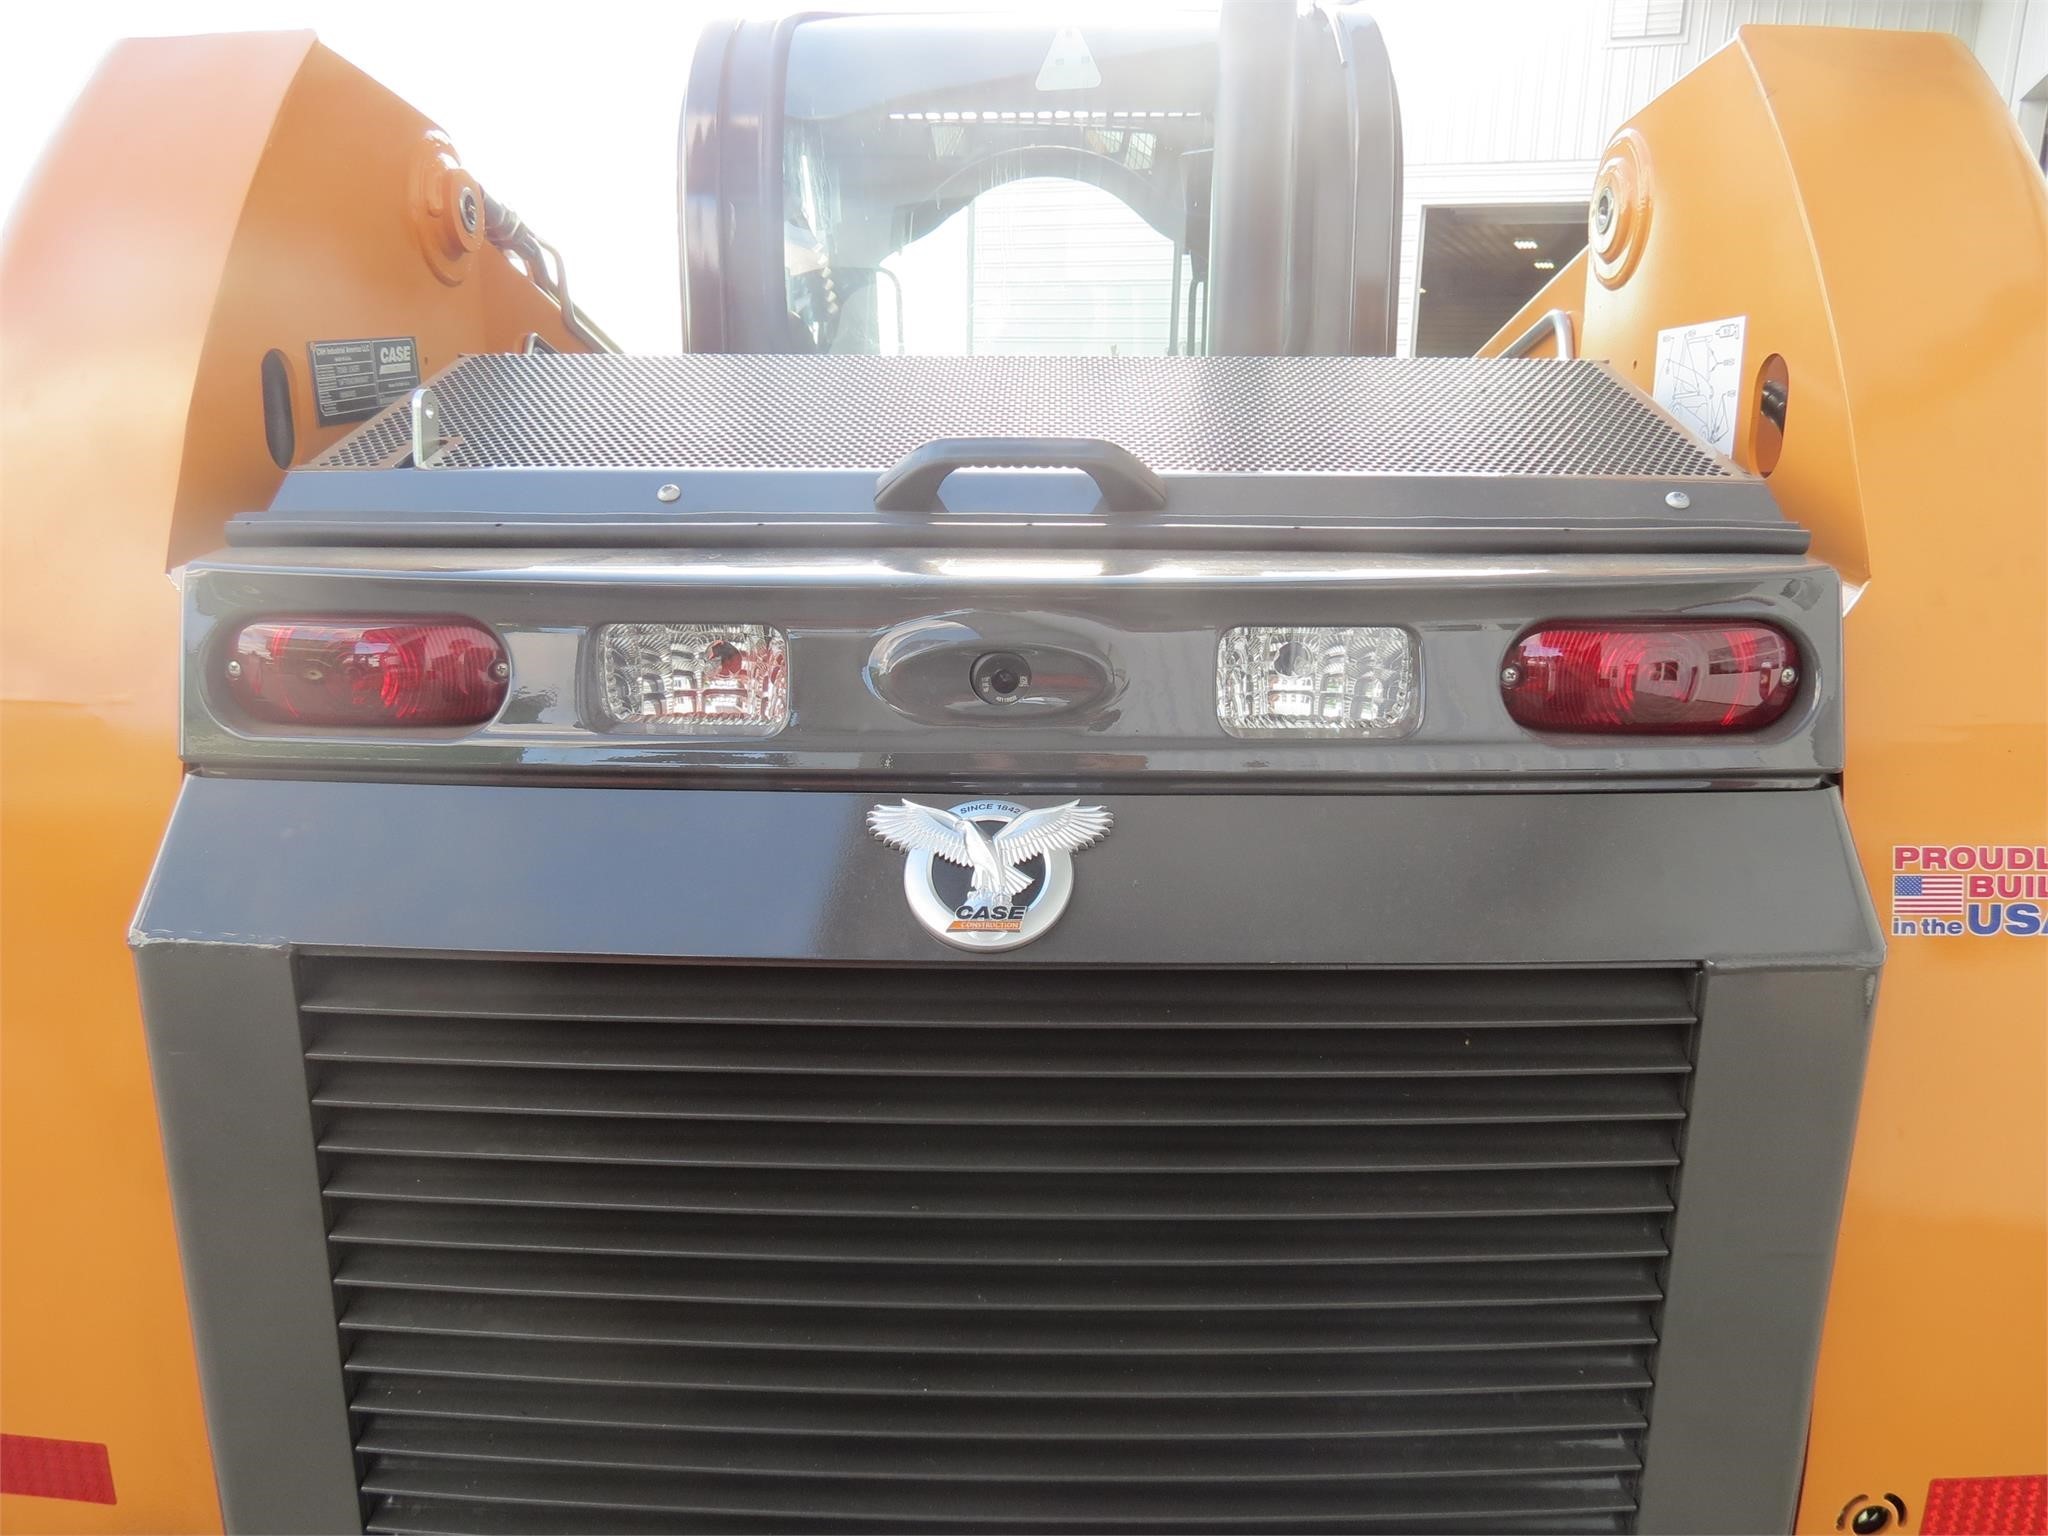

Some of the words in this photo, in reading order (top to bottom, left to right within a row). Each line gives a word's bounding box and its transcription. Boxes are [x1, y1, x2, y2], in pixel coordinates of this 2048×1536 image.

[380, 345, 411, 364] CASE
[960, 803, 993, 814] SINCE
[997, 803, 1021, 815] 1842
[955, 905, 1026, 920] CASE
[1893, 916, 1916, 935] in
[1921, 917, 1964, 935] the
[1967, 903, 2048, 935] US
[960, 921, 1020, 929] CONSTRUCTION
